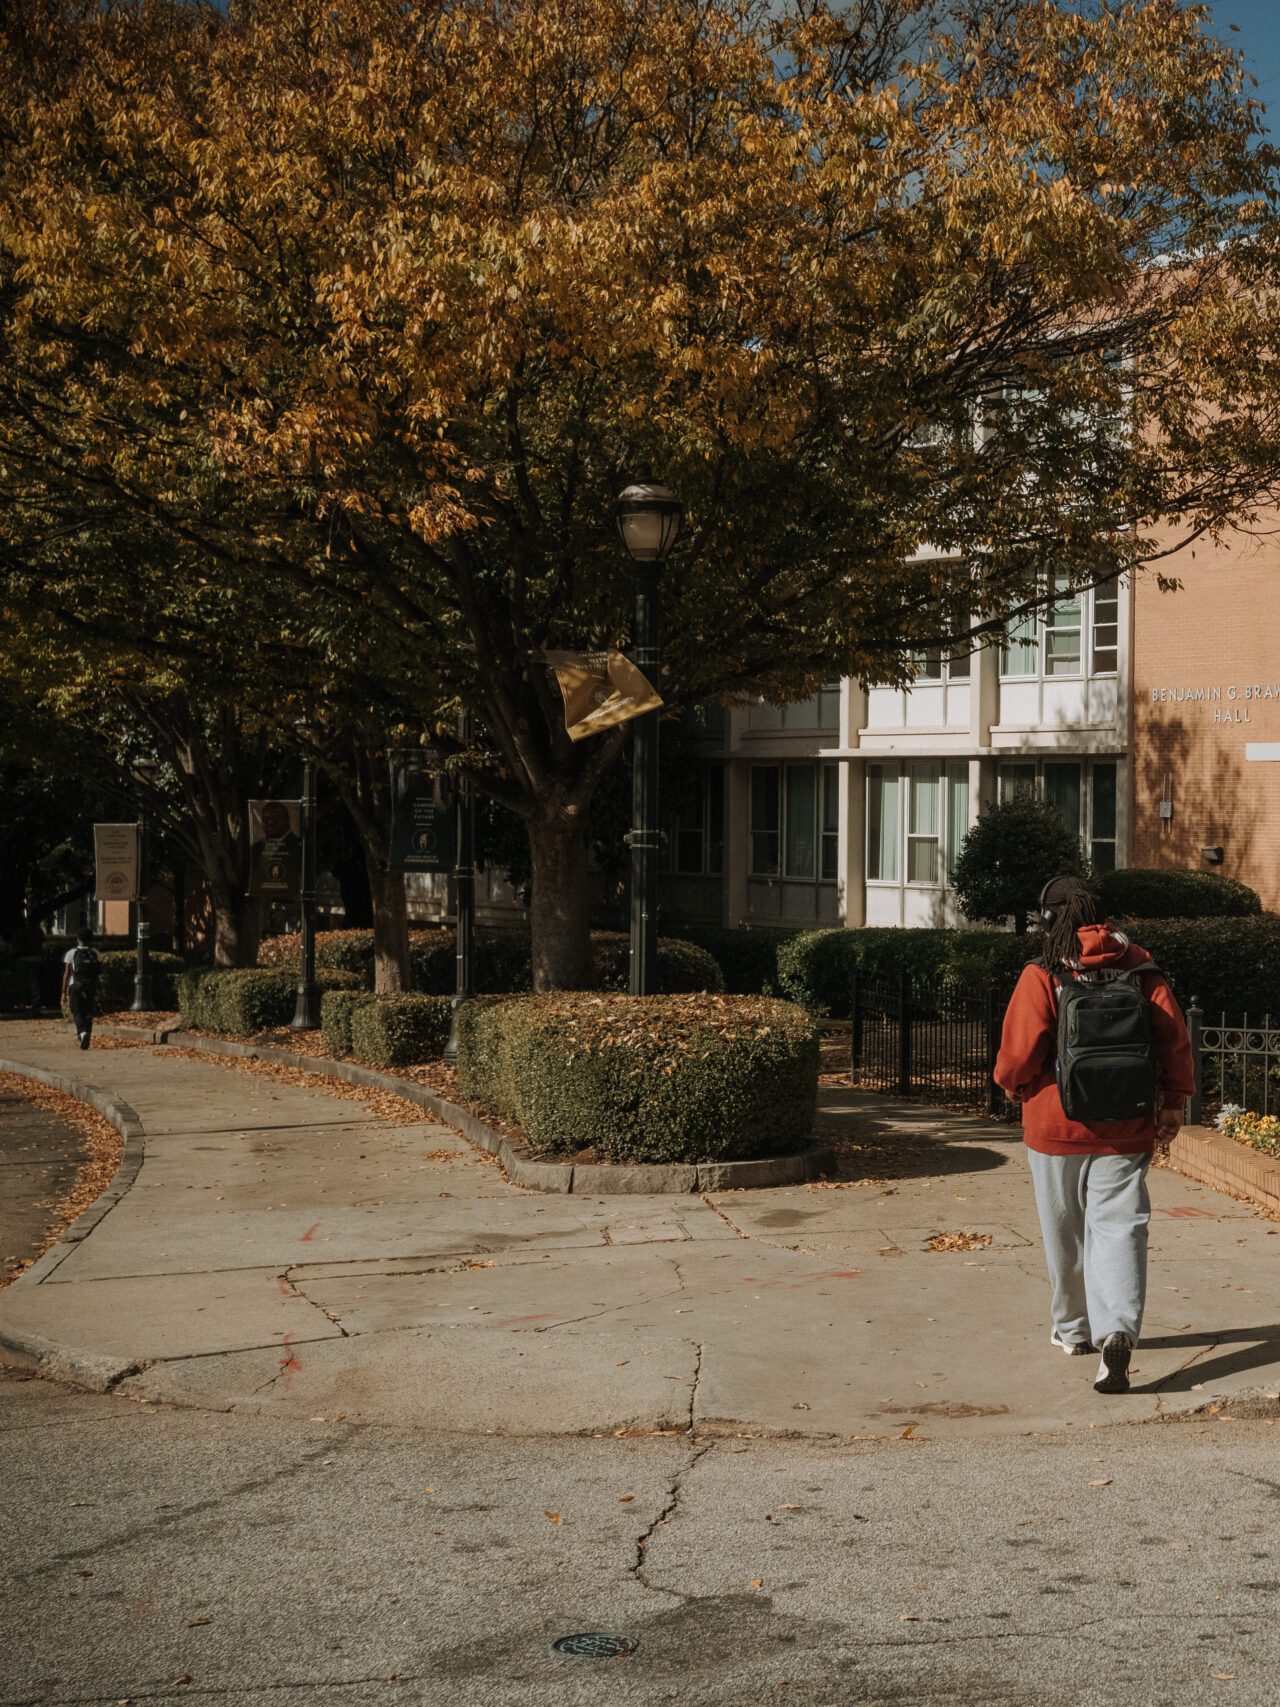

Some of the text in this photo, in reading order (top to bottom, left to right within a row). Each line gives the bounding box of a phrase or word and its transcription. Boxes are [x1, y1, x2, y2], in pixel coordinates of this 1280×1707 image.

[1152, 687, 1221, 702] BENJAMIN
[1227, 685, 1241, 700] G.
[1213, 708, 1252, 723] HALL
